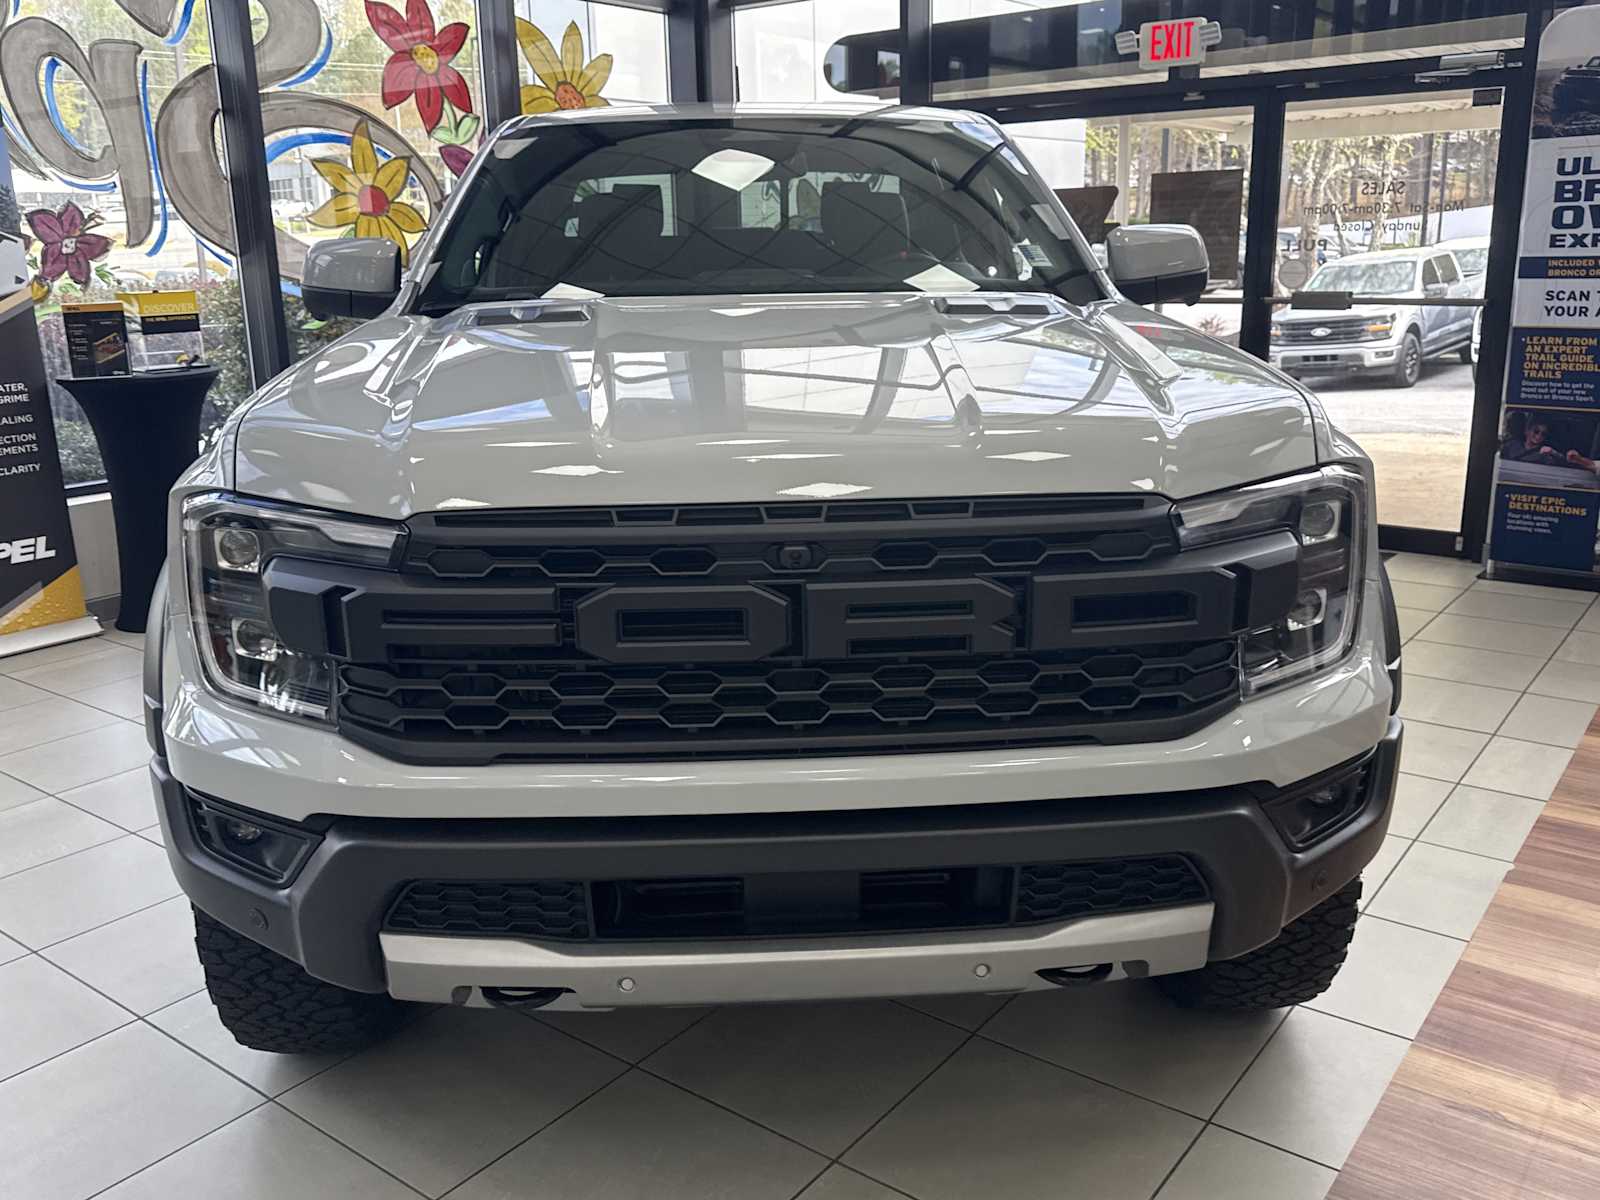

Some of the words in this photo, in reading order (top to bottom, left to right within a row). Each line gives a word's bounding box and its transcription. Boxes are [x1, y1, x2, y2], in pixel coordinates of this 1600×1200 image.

[1151, 21, 1194, 61] EXIT
[1557, 157, 1600, 176] UL
[1548, 259, 1595, 267] INCLUDED
[1548, 269, 1586, 277] BRONCO
[1545, 290, 1590, 302] SCAN
[143, 303, 195, 314] DISCOVER
[1544, 305, 1590, 317] YOUR
[1526, 336, 1563, 345] LEARN
[1567, 336, 1598, 346] FROM
[1525, 345, 1541, 353] AN
[1544, 345, 1588, 354] EXPERT
[1525, 353, 1557, 361] TRAIL
[1559, 354, 1595, 363] GUIDE
[1523, 361, 1539, 370] ON
[1523, 370, 1562, 379] TRAILS
[1510, 494, 1537, 503] VISIT
[1541, 496, 1566, 506] EPIC
[1509, 502, 1587, 516] DESTINATIONS
[342, 567, 1236, 663] FORD
